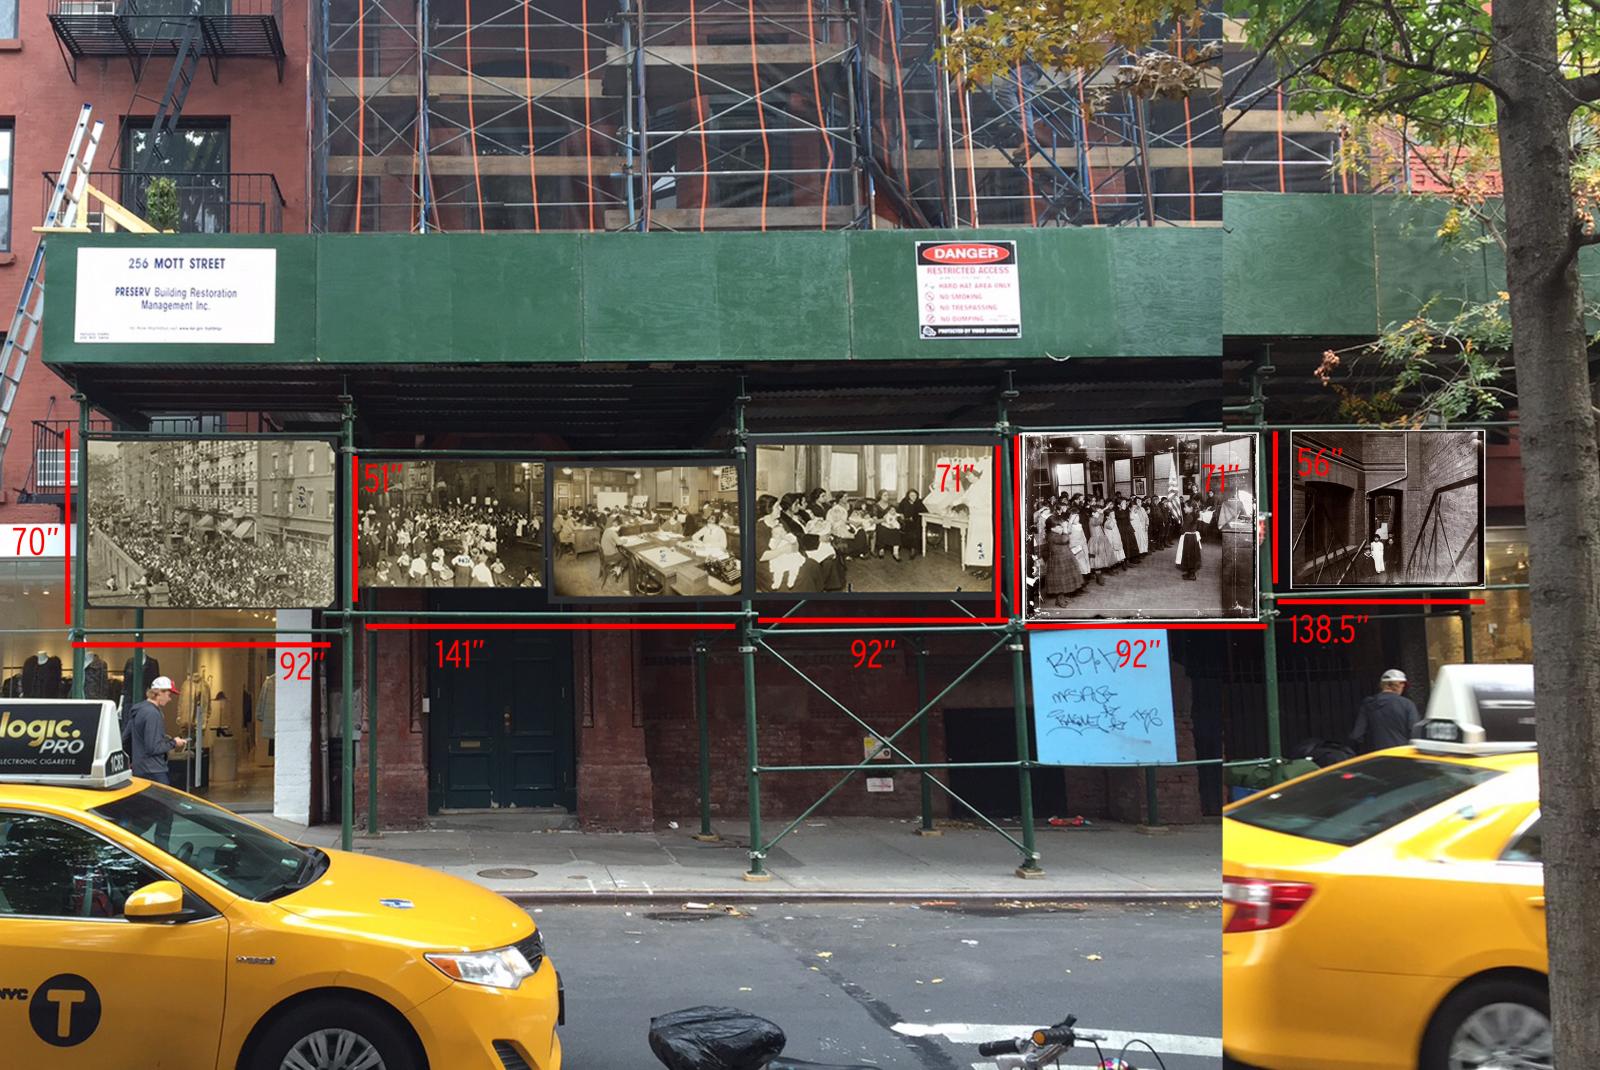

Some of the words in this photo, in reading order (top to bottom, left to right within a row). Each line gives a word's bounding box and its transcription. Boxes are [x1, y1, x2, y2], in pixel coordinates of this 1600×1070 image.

[934, 248, 998, 258] DANGER
[128, 258, 149, 269] 256
[154, 258, 184, 269] MOTT
[189, 258, 225, 269] STREET
[927, 267, 975, 275] RESTRICTED
[978, 267, 1010, 275] ACCESS
[115, 287, 151, 297] PRESERV
[154, 287, 187, 299] Building
[190, 288, 238, 299] Restoration
[141, 300, 193, 312] Management
[196, 301, 211, 311] Inc.
[0, 711, 81, 747] logic.
[39, 740, 84, 754] PRO
[47, 989, 85, 1038] T
